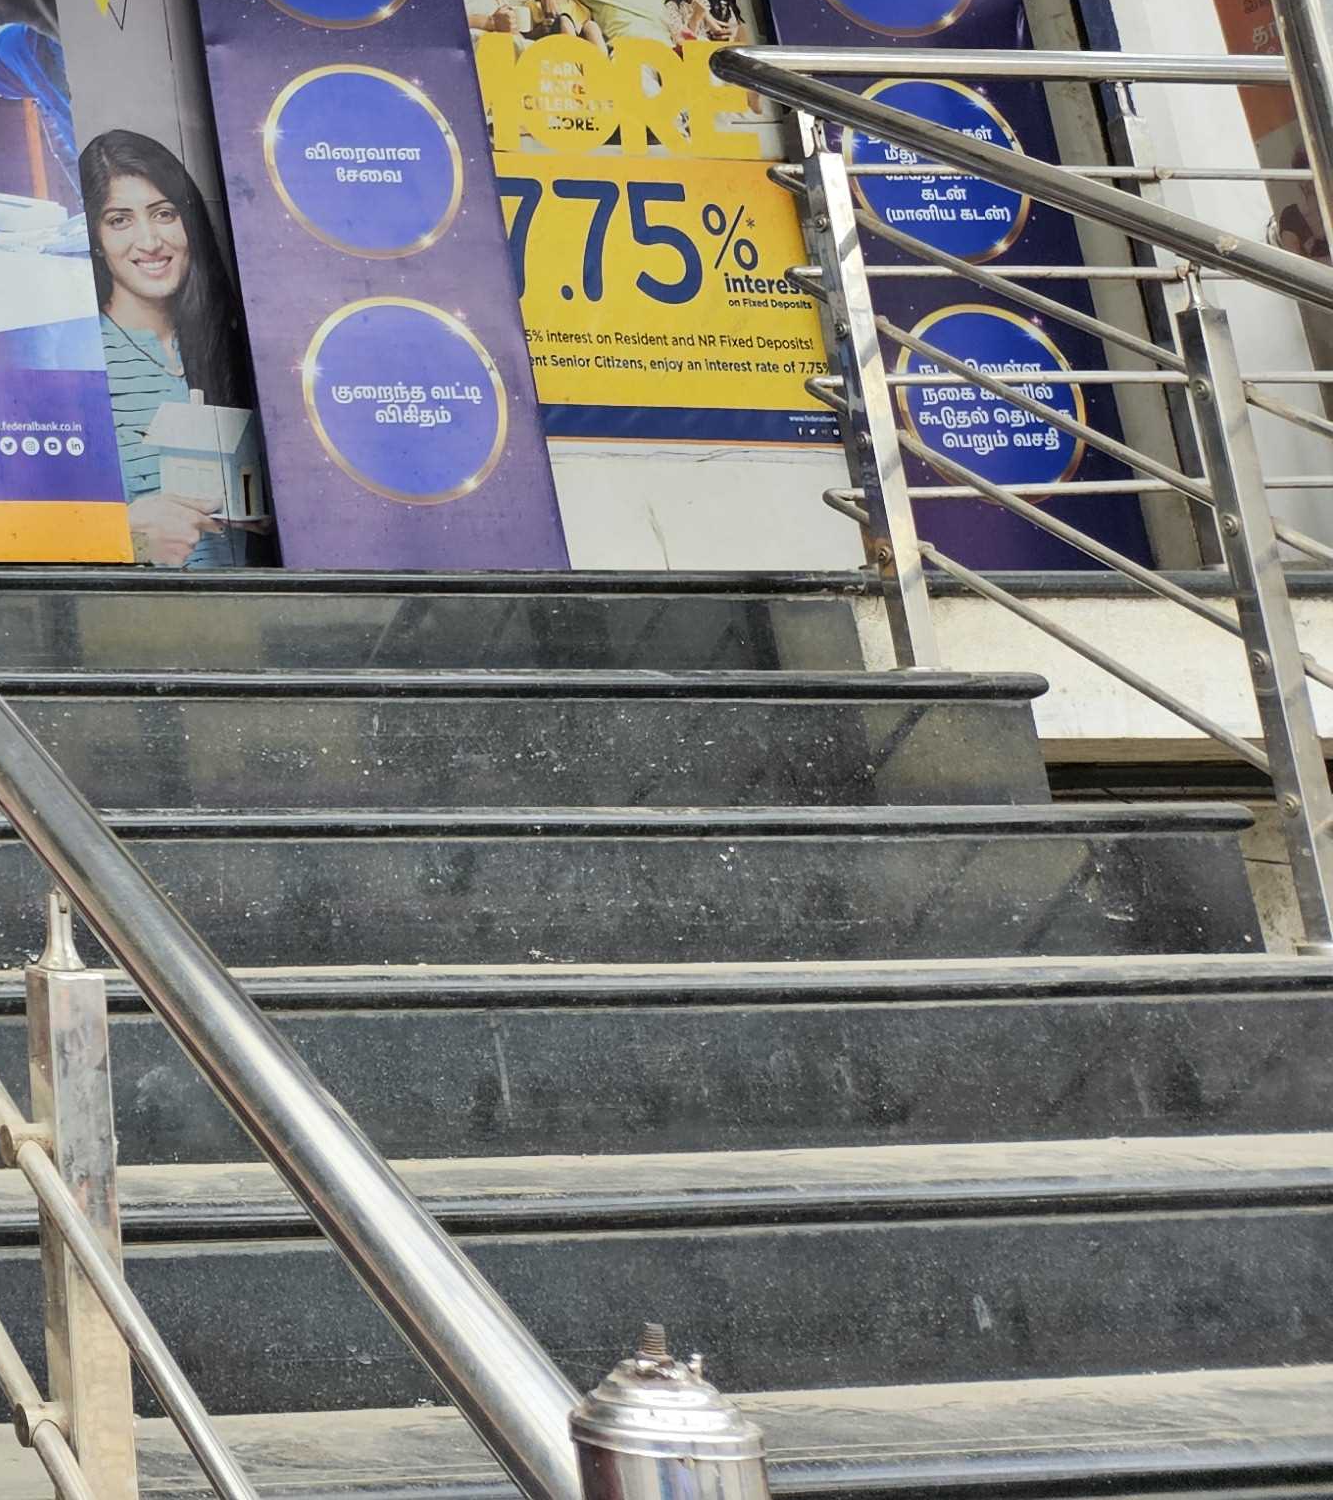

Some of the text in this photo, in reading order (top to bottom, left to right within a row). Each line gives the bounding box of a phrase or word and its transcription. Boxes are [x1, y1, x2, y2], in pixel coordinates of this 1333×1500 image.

[304, 143, 421, 164] விரைவான
[336, 167, 403, 184] சேவை
[921, 185, 967, 201] கடன்
[724, 272, 812, 296] interes
[729, 298, 812, 310] on Fixed Deposits
[546, 331, 813, 350] interest on Resident and NR Fixed Deposits!
[551, 355, 590, 368] Senior
[595, 356, 647, 371] Citizens,
[650, 358, 682, 372] enjoy
[687, 360, 701, 371] an
[705, 359, 752, 372] interest
[756, 362, 779, 373] rate
[783, 361, 795, 373] of
[430, 381, 483, 402] வட்டி
[922, 387, 976, 406] நகை
[375, 403, 451, 427] விகிதம்
[942, 427, 1060, 456] பெறும் வசதி
